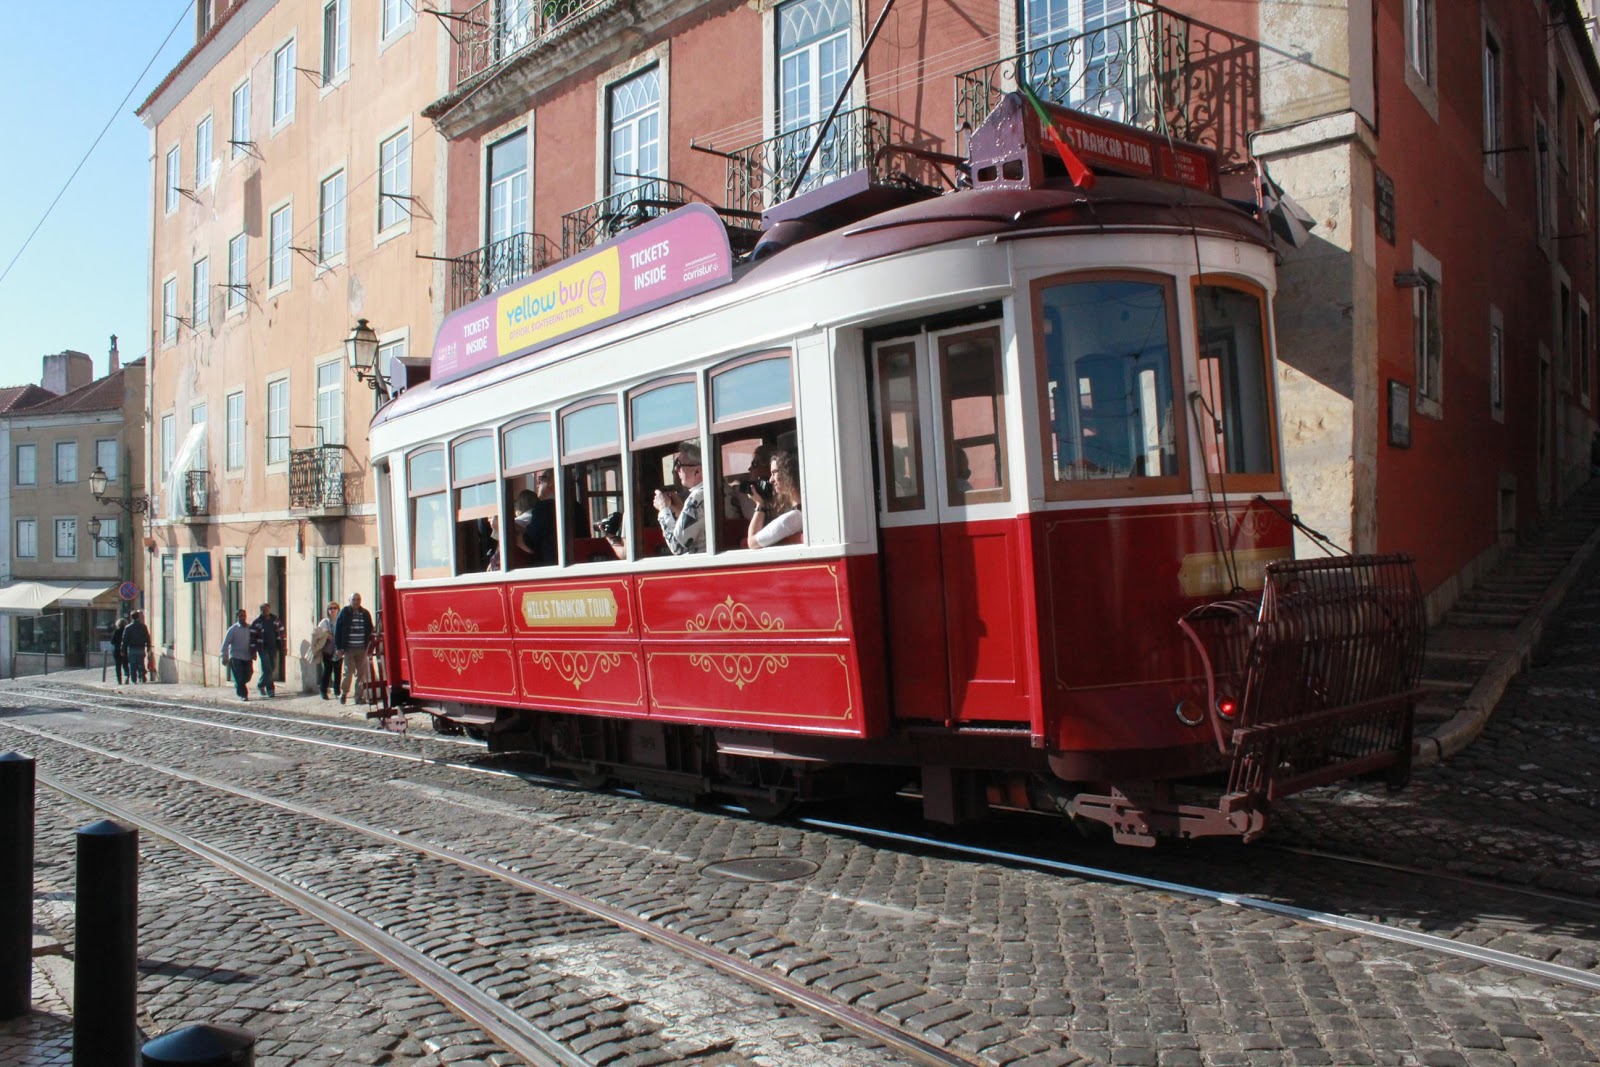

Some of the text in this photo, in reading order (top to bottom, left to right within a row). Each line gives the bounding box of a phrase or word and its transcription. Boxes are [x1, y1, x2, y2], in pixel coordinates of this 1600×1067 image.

[1124, 142, 1151, 166] TOUR
[630, 240, 670, 269] TICKETS
[634, 264, 667, 291] INSIDE
[507, 279, 585, 326] yellow bus
[565, 304, 584, 318] TOURS
[464, 316, 490, 338] TICKETS
[465, 336, 488, 356] INSIDE
[526, 597, 611, 619] HILLS TRAMCAR TOUR
